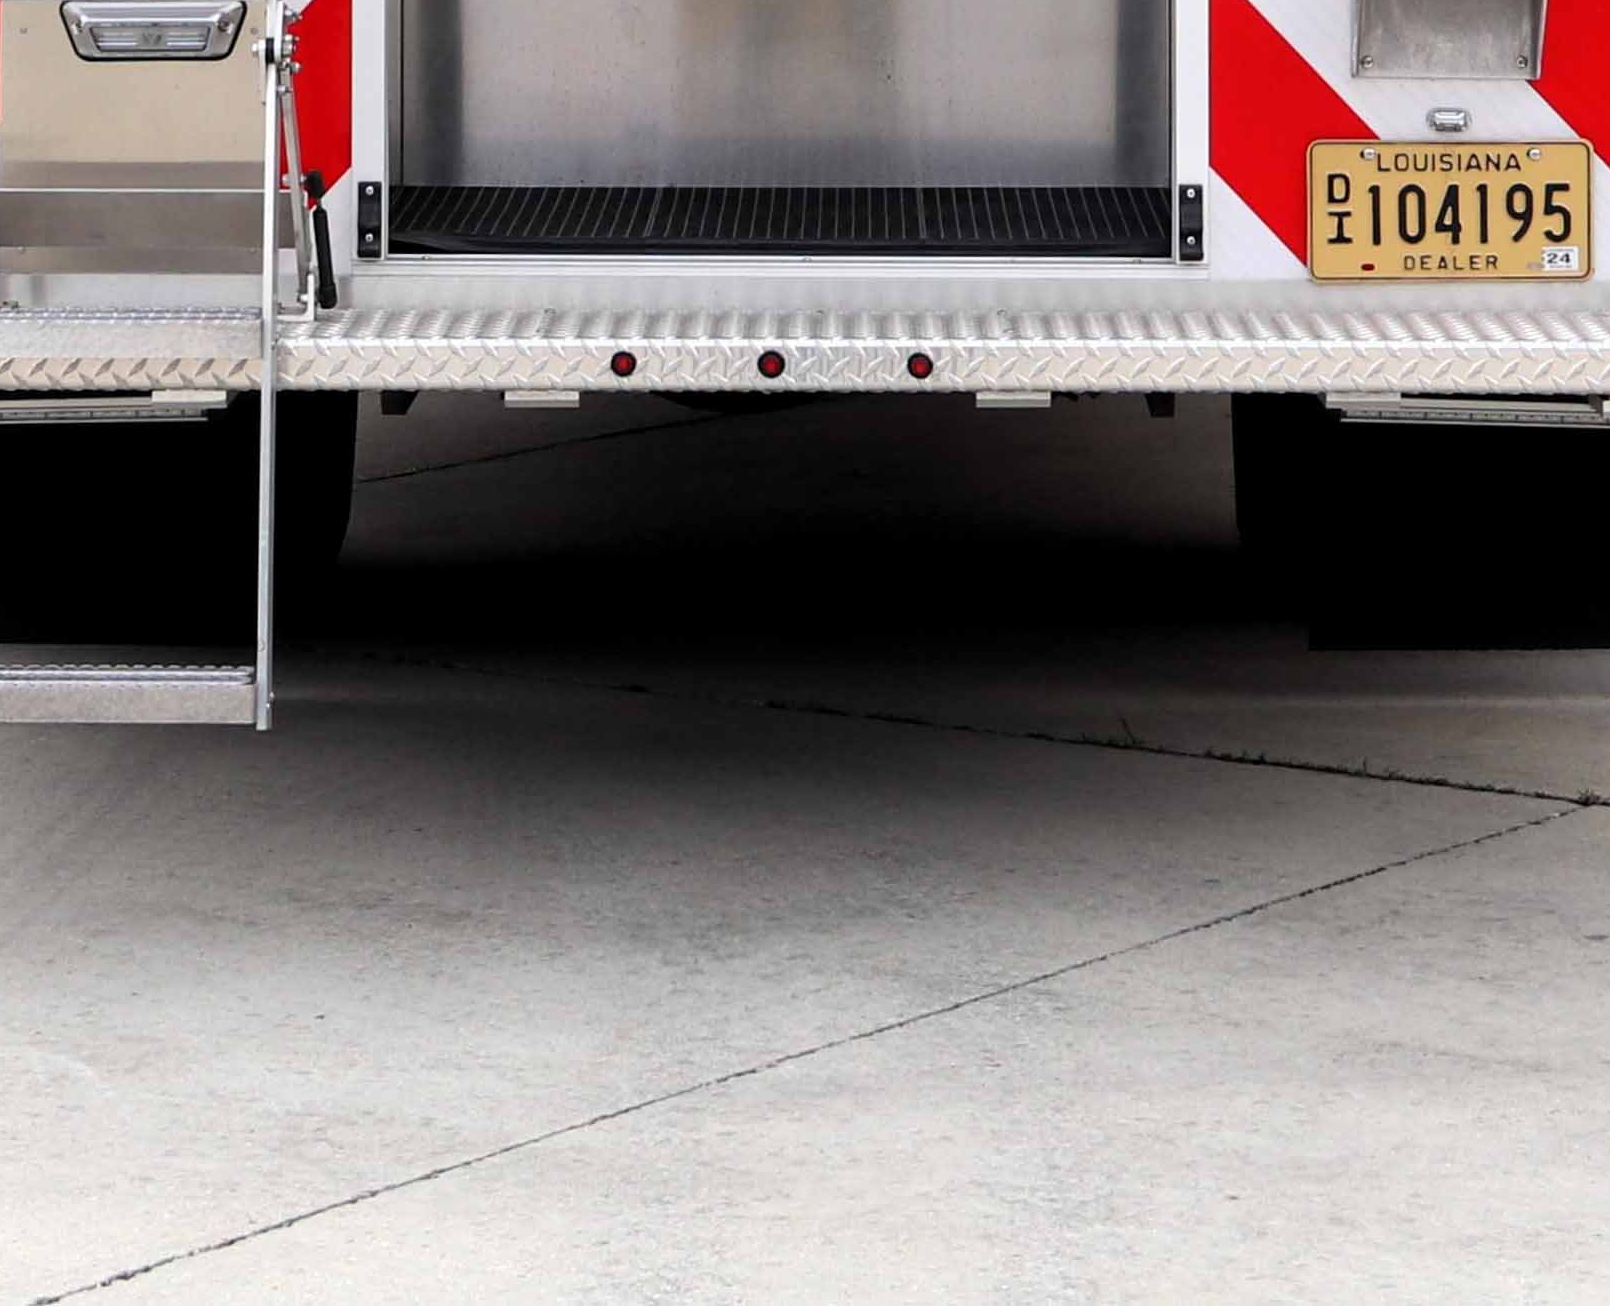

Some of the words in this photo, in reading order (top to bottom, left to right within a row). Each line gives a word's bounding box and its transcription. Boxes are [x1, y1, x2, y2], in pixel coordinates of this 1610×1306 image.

[1376, 153, 1522, 173] LOUISIANA
[1368, 183, 1572, 246] 104195
[1403, 255, 1499, 271] DEALER
[1546, 252, 1571, 264] 24
